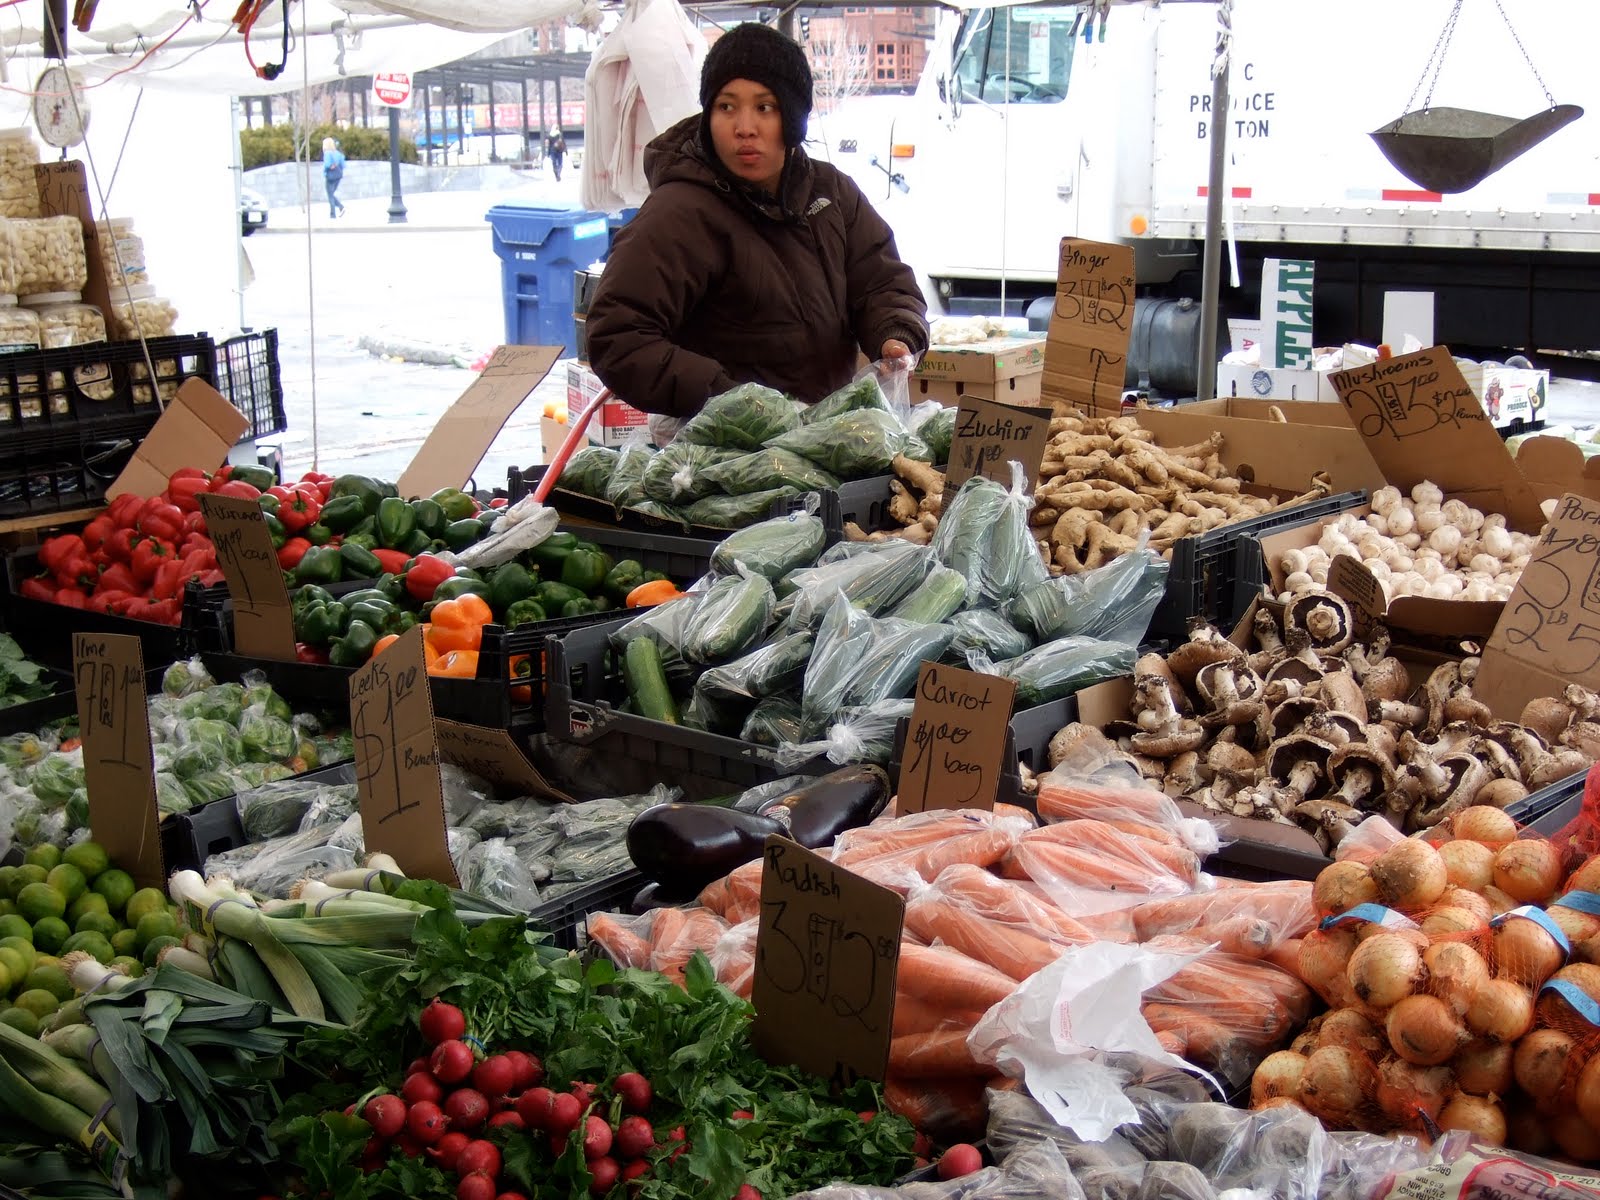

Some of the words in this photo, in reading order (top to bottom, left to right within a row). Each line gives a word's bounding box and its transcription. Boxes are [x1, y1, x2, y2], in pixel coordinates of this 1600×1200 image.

[1190, 93, 1275, 112] PRCE
[1197, 120, 1269, 139] BTON
[1061, 245, 1110, 273] Ginger
[1334, 355, 1434, 392] Mushrooms
[958, 409, 1033, 441] Zuchini
[921, 668, 993, 711] Carrot
[944, 751, 983, 804] bag
[767, 845, 841, 898] Radish
